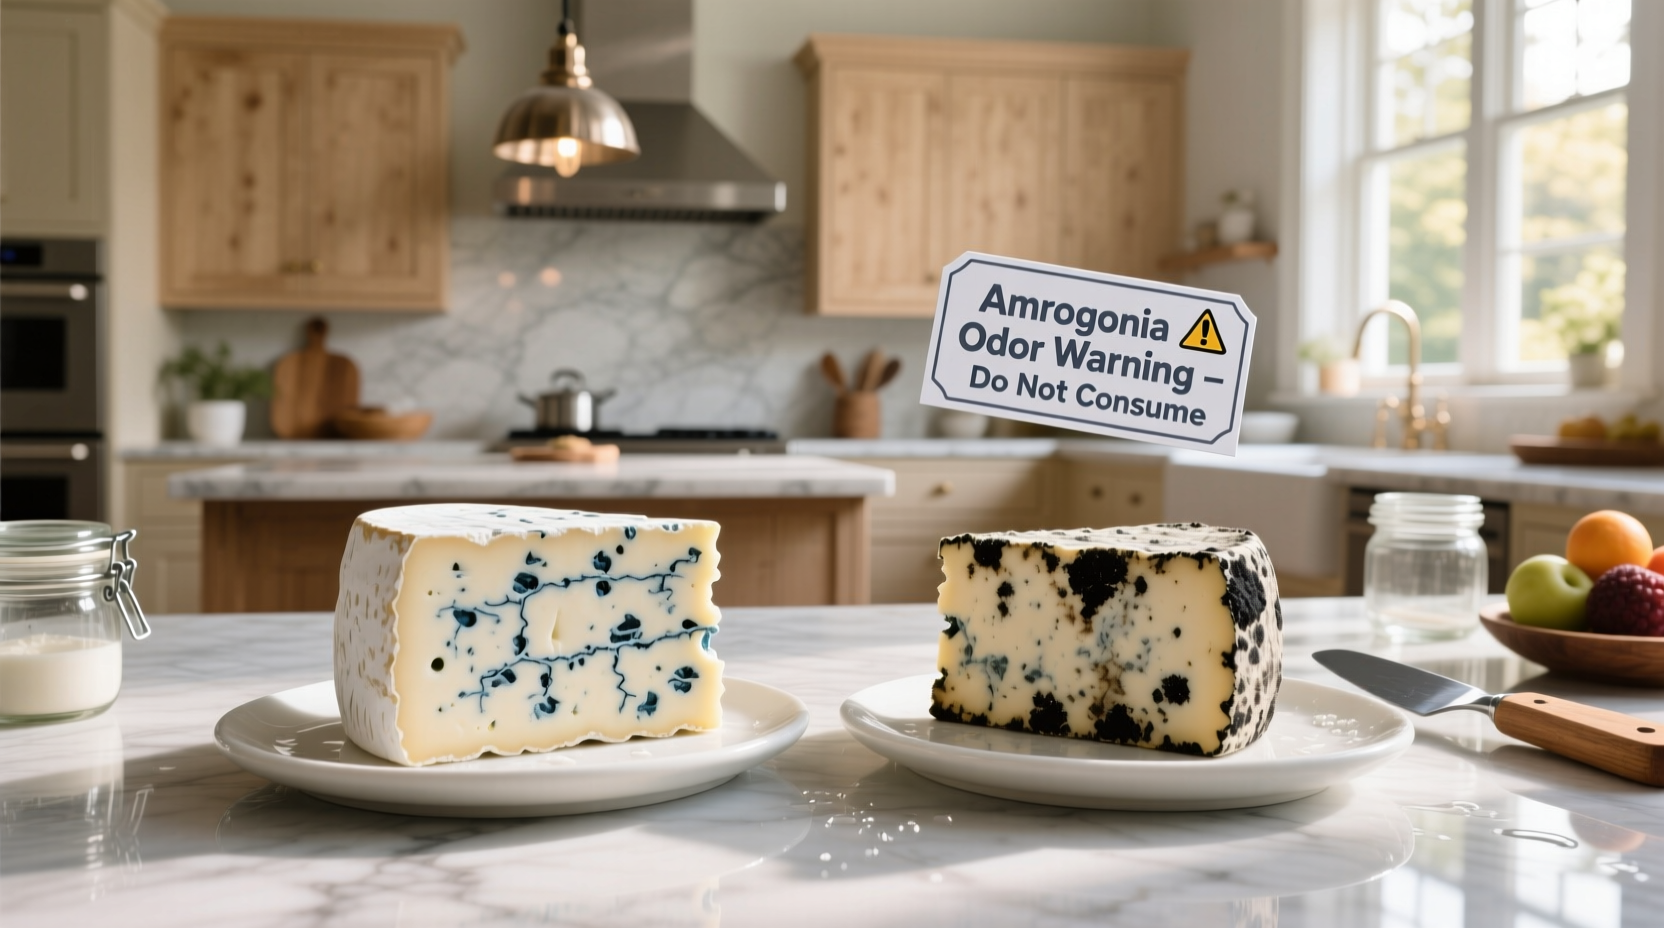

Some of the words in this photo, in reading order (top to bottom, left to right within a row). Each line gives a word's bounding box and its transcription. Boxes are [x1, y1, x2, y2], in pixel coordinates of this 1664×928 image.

[978, 283, 1169, 342] Amrogonia
[958, 322, 1046, 363] Odor
[1054, 335, 1195, 396] Warning
[969, 364, 1009, 393] Do
[1016, 372, 1069, 404] Not
[1075, 382, 1207, 427] Consume
